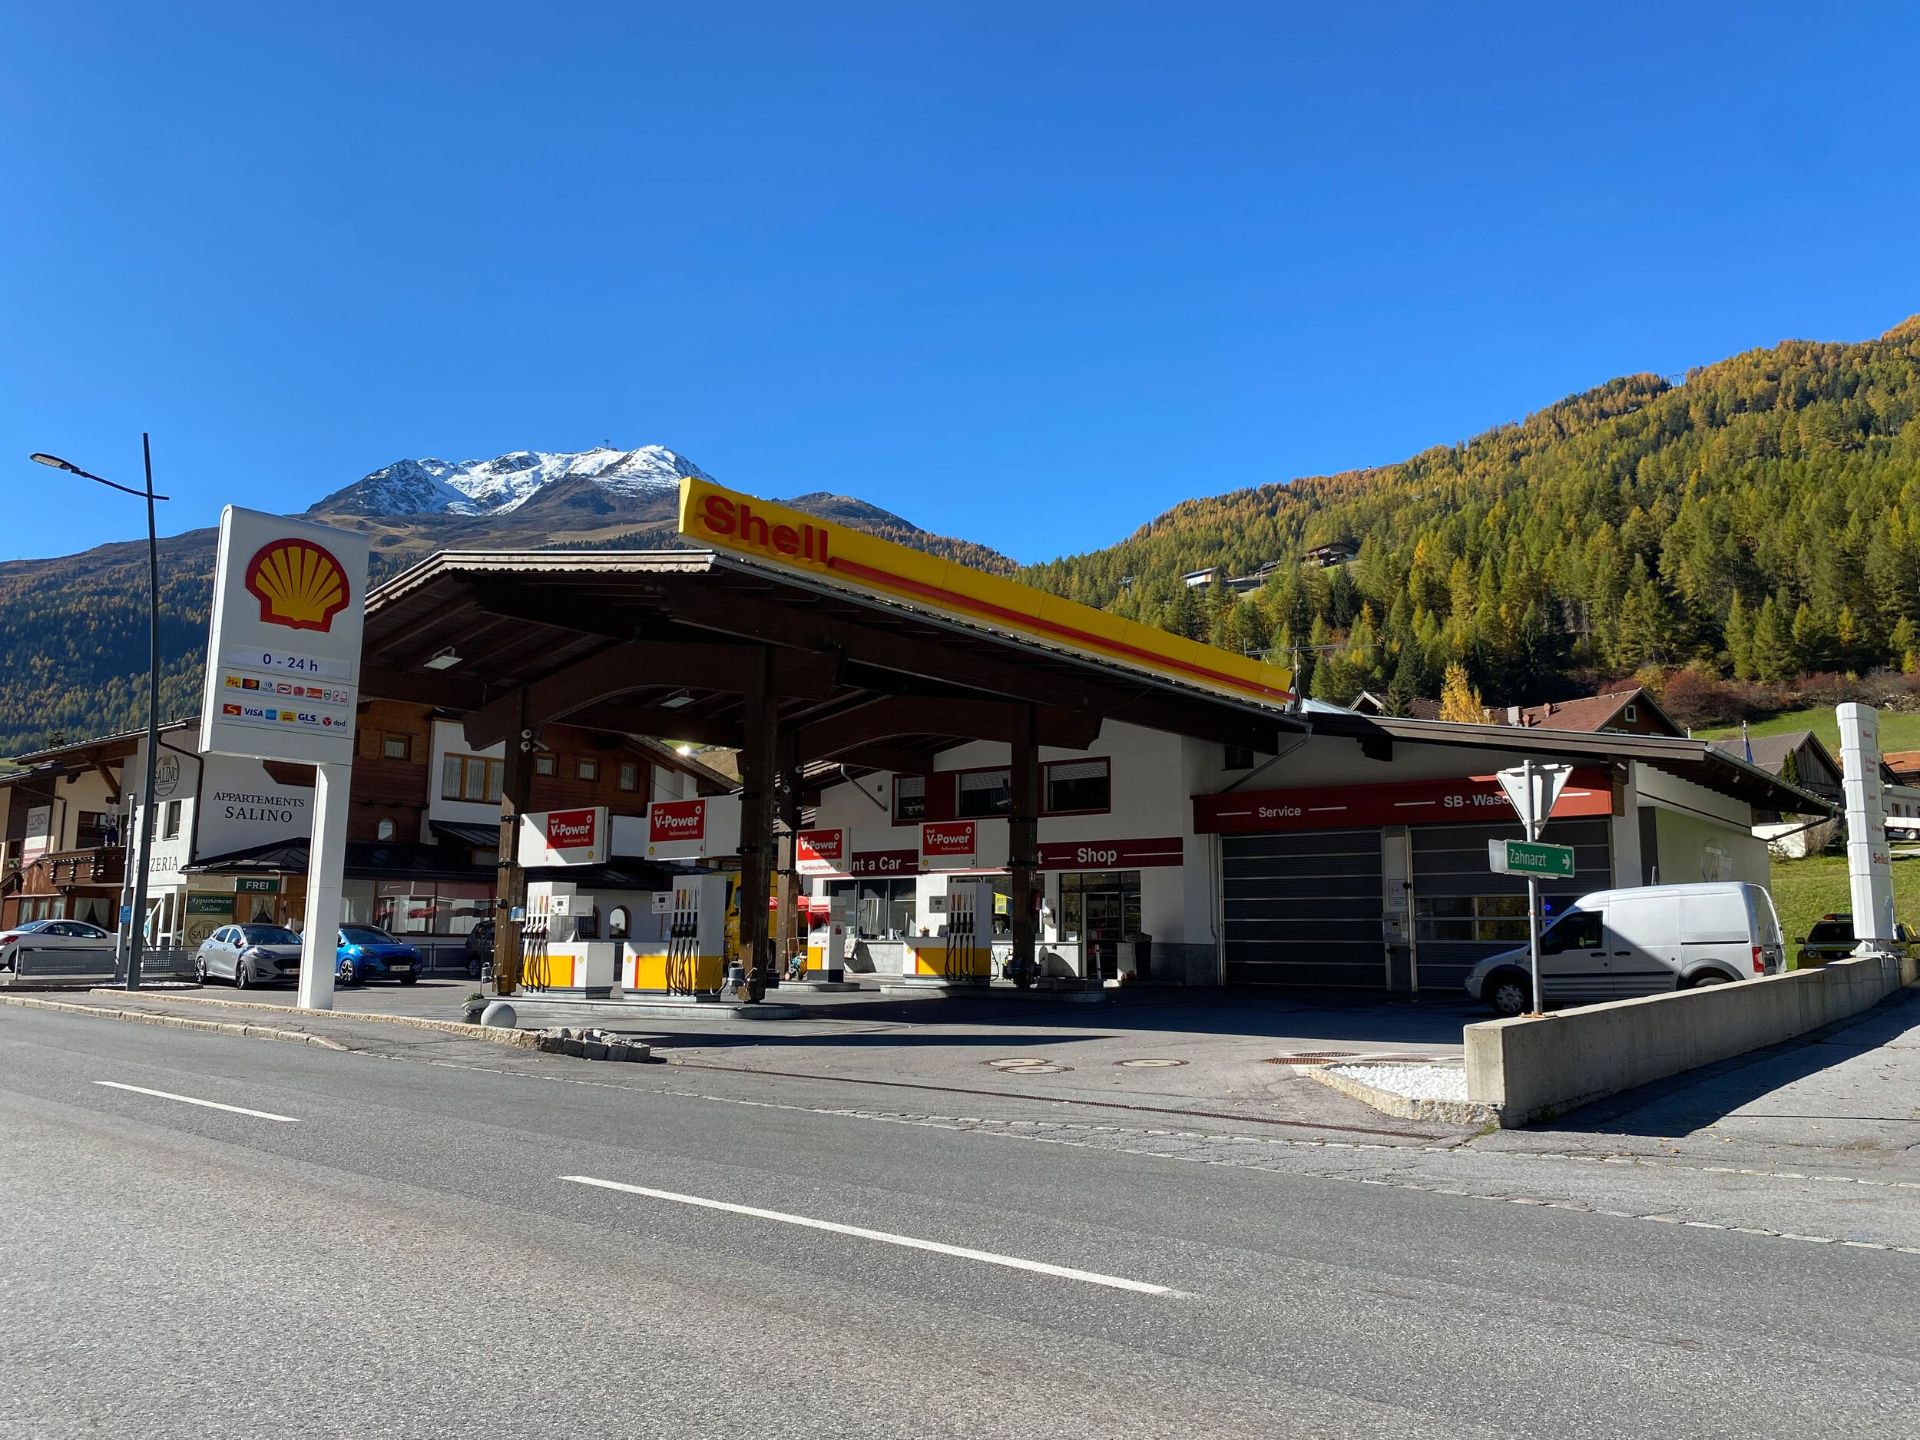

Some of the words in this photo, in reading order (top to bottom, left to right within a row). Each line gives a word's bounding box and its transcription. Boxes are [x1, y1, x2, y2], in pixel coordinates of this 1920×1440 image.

[703, 495, 828, 564] Shell
[263, 653, 271, 665] 0
[288, 657, 305, 670] 24
[310, 659, 318, 672] h
[244, 708, 263, 718] VISA
[298, 713, 316, 723] GLS
[333, 719, 346, 728] dpd
[213, 791, 305, 808] APPARTEMENTS
[224, 806, 294, 823] SALINO
[1258, 804, 1302, 818] Service
[654, 815, 699, 829] V-Power
[551, 824, 590, 837] V-Power
[800, 840, 838, 851] V-Power
[926, 834, 970, 845] V-Power
[868, 861, 876, 871] a
[879, 856, 902, 871] Car
[1077, 847, 1118, 866] Shop
[1510, 848, 1547, 867] Zahnarzt
[245, 881, 269, 892] FREI
